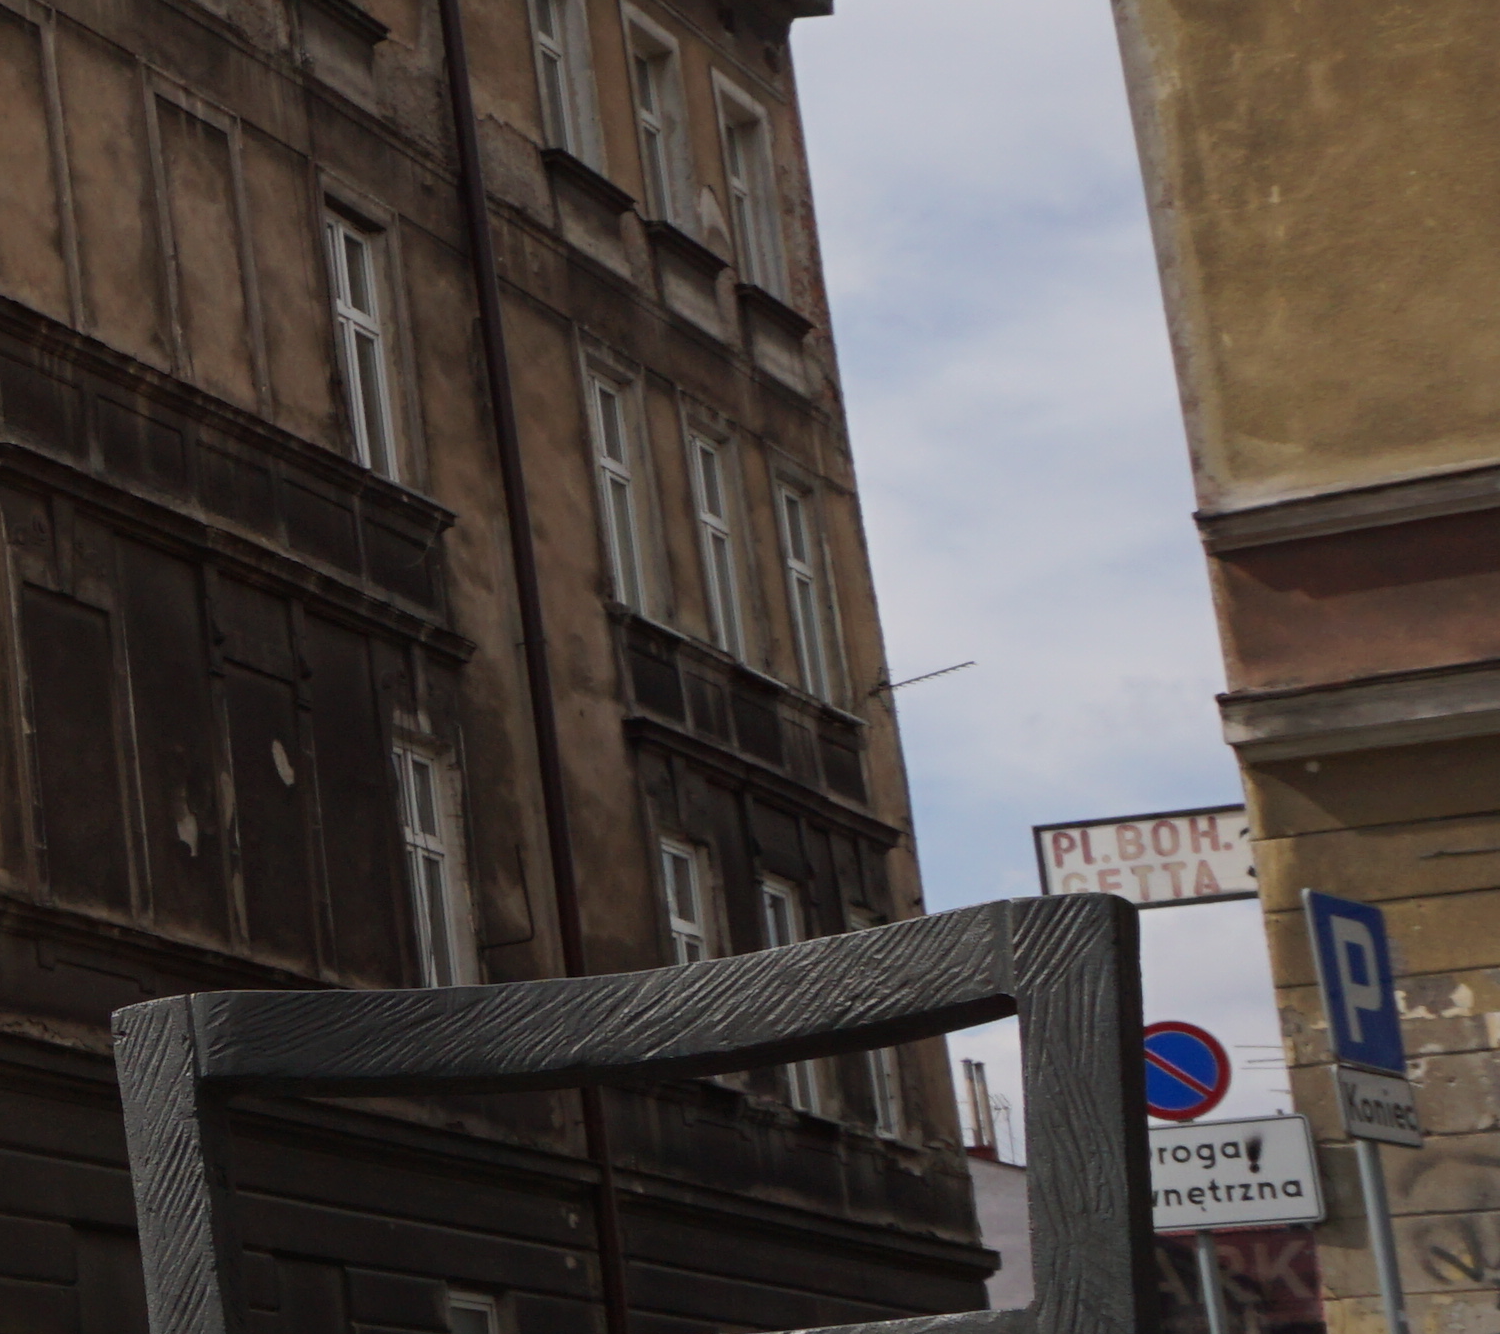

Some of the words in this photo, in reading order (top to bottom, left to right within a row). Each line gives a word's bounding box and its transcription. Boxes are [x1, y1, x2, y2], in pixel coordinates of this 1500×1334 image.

[1330, 915, 1382, 1044] P
[1343, 1080, 1418, 1131] Koniec
[1150, 1141, 1242, 1170] roga
